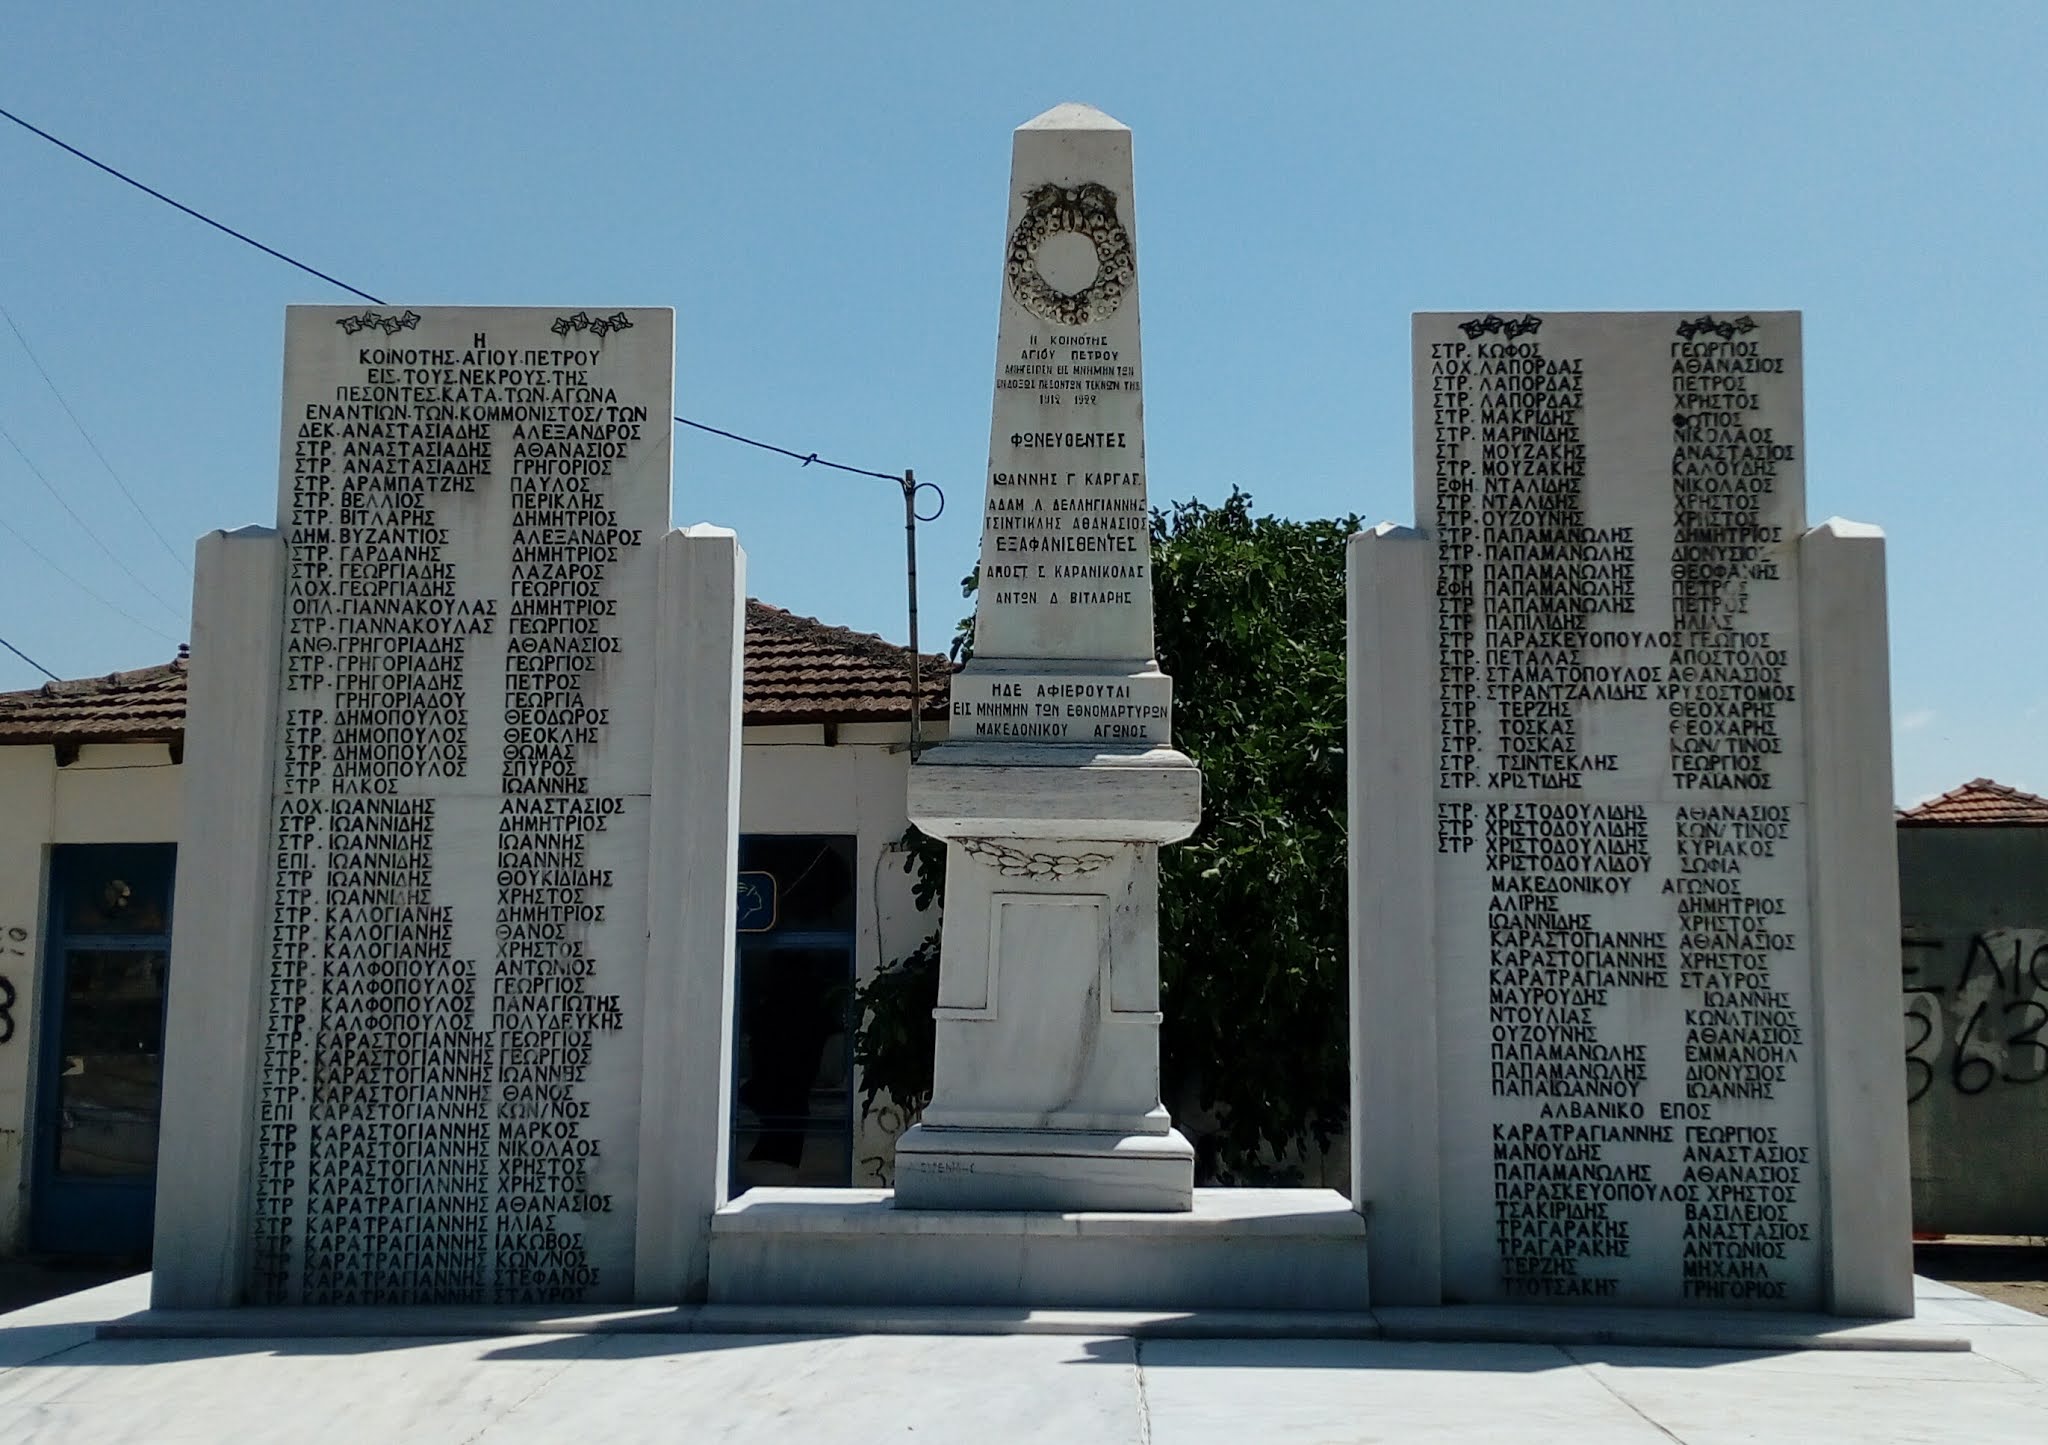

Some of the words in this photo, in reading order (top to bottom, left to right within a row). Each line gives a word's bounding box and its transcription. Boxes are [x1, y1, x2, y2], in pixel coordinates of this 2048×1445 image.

[475, 333, 485, 348] Η
[525, 351, 599, 365] ΠΕΤΡΟΥ
[1072, 351, 1118, 360] ΠΕΤΡΟΥ
[1479, 344, 1541, 358] ΚΩΦΟΣ
[1480, 360, 1582, 374] ΛΑΠΟΡΔΑΣ
[1672, 359, 1783, 373] ΑΘΑΝΑΣΙΟΣ
[553, 371, 587, 385] ΤΗΣ
[1480, 377, 1582, 391] ΛΑΠΟΡΔΑΣ
[1673, 376, 1745, 391] ΠΕΤΡΟΣ
[552, 388, 616, 402] ΑΓΩΝΑ
[1481, 393, 1583, 408] ΛΑΠΟΡΔΑΣ
[1675, 394, 1759, 409] ΧΡΗΣΤΟΣ
[1482, 410, 1574, 424] ΜΑΚΡΙΔΗΣ
[513, 425, 640, 439] ΑΛΕΞΑΝΔΡΟΣ
[1011, 433, 1125, 447] ΦΩΝΕΥΘΕΝΤΕΣ
[344, 442, 491, 457] ΑΝΑΣΤΑΣΙΑΔΗΣ
[514, 443, 626, 457] ΑΘΑΝΑΣΙΟΣ
[1483, 445, 1586, 459] ΜΟΥΖΑΚΗΣ
[344, 459, 491, 474] ΑΝΑΣΤΑΣΙΑΔΗΣ
[514, 460, 611, 475] ΓΡΗΓΟΡΙΟΣ
[1483, 461, 1585, 475] ΜΟΥΖΑΚΗΣ
[511, 477, 589, 492] ΠΑΥΛΟΣ
[994, 474, 1056, 485] ΙΩΑΝΝΗΣ
[1486, 478, 1581, 493] ΝΤΑΛΙΔΗΣ
[512, 494, 603, 508] ΠΕΡΙΚΛΗΣ
[989, 499, 1023, 510] ΑΔΑΜ
[1053, 499, 1147, 510] ΔΕΛΛΗΓΙΑΝΝΗΣ
[1483, 495, 1578, 509] ΝΤΑΛΙΔΗΣ
[513, 511, 617, 526] ΔΗΜΗΤΡΙΟΣ
[987, 517, 1060, 529] ΤΣΙΝΤΙΚΛΗΣ
[1073, 518, 1146, 529] ΑΘΑΝΑΣΙΟΣ
[1483, 511, 1584, 526] ΟΥΖΟΥΝΗΣ
[340, 529, 448, 544] ΒΥΖΑΝΤΙΟΣ
[513, 530, 642, 544] ΑΛΕΞΑΝΔΡΟΣ
[1484, 528, 1632, 543] ΠΑΠΑΜΑΝΩΛΗΣ
[997, 537, 1136, 551] ΕΞΑΦΑΝΙΣΘΕΝΤΕΣ
[341, 546, 440, 561] ΓΑΡΔΑΝΗΣ
[512, 547, 617, 562] ΔΗΜΗΤΡΙΟΣ
[1486, 546, 1634, 561] ΠΑΠΑΜΑΝΩΛΗΣ
[341, 564, 455, 579] ΓΕΩΡΓΙΑΔΗΣ
[512, 564, 604, 579] ΛΑΖΑΡΟΣ
[1039, 566, 1045, 577] Σ
[1055, 566, 1143, 577] ΚΑΡΑΝΙΚΟΛΑΣ
[1484, 564, 1634, 579] ΠΑΠΑΜΑΝΩΛΗΣ
[340, 581, 455, 596] ΓΕΩΡΓΙΑΔΗΣ
[512, 581, 599, 596] ΓΕΩΡΓΙΟΣ
[1484, 581, 1634, 595] ΠΑΠΑΜΑΝΩΛΗΣ
[997, 593, 1036, 603] ΑΝΤΩΝ
[1051, 593, 1057, 604] Δ
[1071, 592, 1131, 603] ΒΙΤΛΑΡΗΣ
[1484, 598, 1634, 612] ΠΑΠΑΜΑΝΩΛΗΣ
[511, 600, 617, 615] ΔΗΜΗΤΡΙΟΣ
[510, 618, 598, 633] ΓΕΩΡΓΙΟΣ
[339, 637, 464, 652] ΓΡΗΓΟΡΙΑΔΗΣ
[508, 638, 621, 652] ΑΘΑΝΑΣΙΟΣ
[337, 656, 463, 671] ΓΡΗΓΟΡΙΑΔΗΣ
[1487, 650, 1580, 665] ΠΕΤΑΛΑΣ
[1670, 650, 1787, 665] ΑΠΟΣΤΟΛΟΣ
[337, 675, 463, 690] ΓΡΗΓΟΡΙΑΔΗΣ
[506, 674, 580, 689] ΠΕΤΡΟΣ
[1487, 667, 1661, 682] ΣΤΑΜΑΤΟΠΟΥΛΟΣ
[993, 684, 1021, 696] ΗΔΕ
[1037, 685, 1129, 697] ΑΦΙΕΡΟΥΤΑΙ
[1487, 685, 1647, 699] ΣΤΡΑΝΤΖΑΛΙΔΗΣ
[336, 693, 465, 708] ΓΡΗΓΟΡΙΑΔΟΥ
[954, 702, 971, 715] ΕΙΣ
[977, 704, 1027, 716] ΜΝΗΜΗΝ
[1036, 704, 1058, 716] ΤΩΝ
[1068, 706, 1167, 717] ΕΘΝΟΜΑΡΤΥΡΩΝ
[1499, 702, 1571, 717] ΤΕΡΖΗΣ
[1669, 702, 1775, 717] ΘΕΟΧΑΡΗΣ
[335, 710, 468, 725] ΔΗΜΟΠΟΥΛΟΣ
[505, 710, 608, 724] ΘΕΟΔΩΡΟΣ
[977, 724, 1067, 735] ΜΑΚΕΔΟΝΙΚΟΥ
[1094, 725, 1147, 737] ΑΓΩΝΟΣ
[1499, 720, 1574, 734] ΤΟΣΚΑΣ
[333, 728, 466, 743] ΔΗΜΟΠΟΥΛΟΣ
[504, 728, 598, 743] ΘΕΟΚΛΗΣ
[1499, 737, 1575, 752] ΤΟΣΚΑΣ
[334, 745, 467, 760] ΔΗΜΟΠΟΥΛΟΣ
[504, 745, 574, 759] ΘΩΜΑΣ
[333, 762, 466, 776] ΔΗΜΟΠΟΥΛΟΣ
[503, 761, 576, 776] ΣΠΥΡΟΣ
[1672, 756, 1762, 770] ΓΕΩΡΓΙΟΣ
[503, 778, 587, 793] ΙΩΑΝΝΗΣ
[1673, 774, 1771, 789] ΤΡΑΙΑΝΟΣ
[332, 799, 435, 814] ΙΩΑΝΝΙΔΗΣ
[500, 798, 624, 814] ΑΝΑΣΤΑΣΙΟΣ
[330, 817, 434, 831] ΙΩΑΝΝΙΔΗΣ
[499, 816, 606, 831] ΔΗΜΗΤΡΙΟΣ
[499, 834, 584, 849] ΙΩΑΝΝΗΣ
[499, 853, 583, 867] ΙΩΑΝΝΗΣ
[1492, 877, 1631, 892] ΜΑΚΕΔΟΝΙΚΟΥ
[1662, 879, 1740, 894] ΑΓΩΝΟΣ
[498, 889, 584, 904] ΧΡΗΣΤΟΣ
[1678, 898, 1785, 913] ΔΗΜΗΤΡΙΟΣ
[496, 906, 604, 921] ΔΗΜΗΤΡΙΟΣ
[1489, 914, 1592, 929] ΙΩΑΝΝΙΔΗΣ
[1680, 916, 1767, 932] ΧΡΗΣΤΟΣ
[1680, 934, 1794, 949] ΑΘΑΝΑΣΙΟΣ
[1491, 951, 1666, 967] ΚΑΡΑΣΤΟΓΙΑΝΝΗΣ
[1681, 954, 1767, 969] ΧΡΗΣΤΟΣ
[495, 978, 584, 993] ΓΕΩΡΓΙΟΣ
[1681, 973, 1770, 988] ΣΤΑΥΡΟΣ
[321, 1015, 473, 1030] ΚΑΛΦΟΠΟΥΛΟΣ
[1491, 1008, 1591, 1023] ΝΤΟΥΛΙΑΣ
[501, 1031, 592, 1047] ΓΕΩΡΓΙΟΣ
[1493, 1026, 1597, 1042] ΟΥΖΟΥΝΗΣ
[1687, 1029, 1802, 1044] ΑΘΑΝΑΣΙΟΣ
[500, 1049, 591, 1064] ΓΕΩΡΓΙΟΣ
[1492, 1045, 1646, 1060] ΠΑΠΑΜΑΝΩΛΗΣ
[1686, 1047, 1797, 1062] ΕΜΜΑΝΟΗΛ
[1686, 1065, 1785, 1080] ΔΙΟΝΥΣΙΟΣ
[503, 1085, 573, 1100] ΘΑΝΟΣ
[1687, 1083, 1773, 1098] ΙΩΑΝΝΗΣ
[1541, 1103, 1643, 1118] ΑΛΒΑΝΙΚΟ
[1661, 1103, 1710, 1119] ΕΠΟΣ
[499, 1122, 579, 1138] ΜΑΡΚΟΣ
[1686, 1127, 1777, 1143] ΓΕΩΡΓΙΟΣ
[499, 1141, 600, 1156] ΝΙΚΟΛΑΟΣ
[1494, 1144, 1601, 1160] ΜΑΝΟΥΔΗΣ
[1683, 1147, 1808, 1162] ΑΝΑΣΤΑΣΙΟΣ
[498, 1159, 585, 1174] ΧΡΗΣΤΟΣ
[1495, 1164, 1651, 1180] ΠΑΠΑΜΑΝΩΛΗΣ
[1683, 1167, 1800, 1182] ΑΘΑΝΑΣΙΟΣ
[1707, 1186, 1796, 1202] ΧΡΗΣΤΟΣ
[496, 1196, 611, 1212] ΑΘΑΝΑΣΙΟΣ
[1686, 1205, 1788, 1221] ΒΑΣΙΛΕΙΟΣ
[498, 1215, 555, 1231] ΗΛΙΑΣ
[1683, 1223, 1809, 1239] ΑΝΑΣΤΑΣΙΟΣ
[1683, 1242, 1786, 1258] ΑΝΤΩΝΙΟΣ
